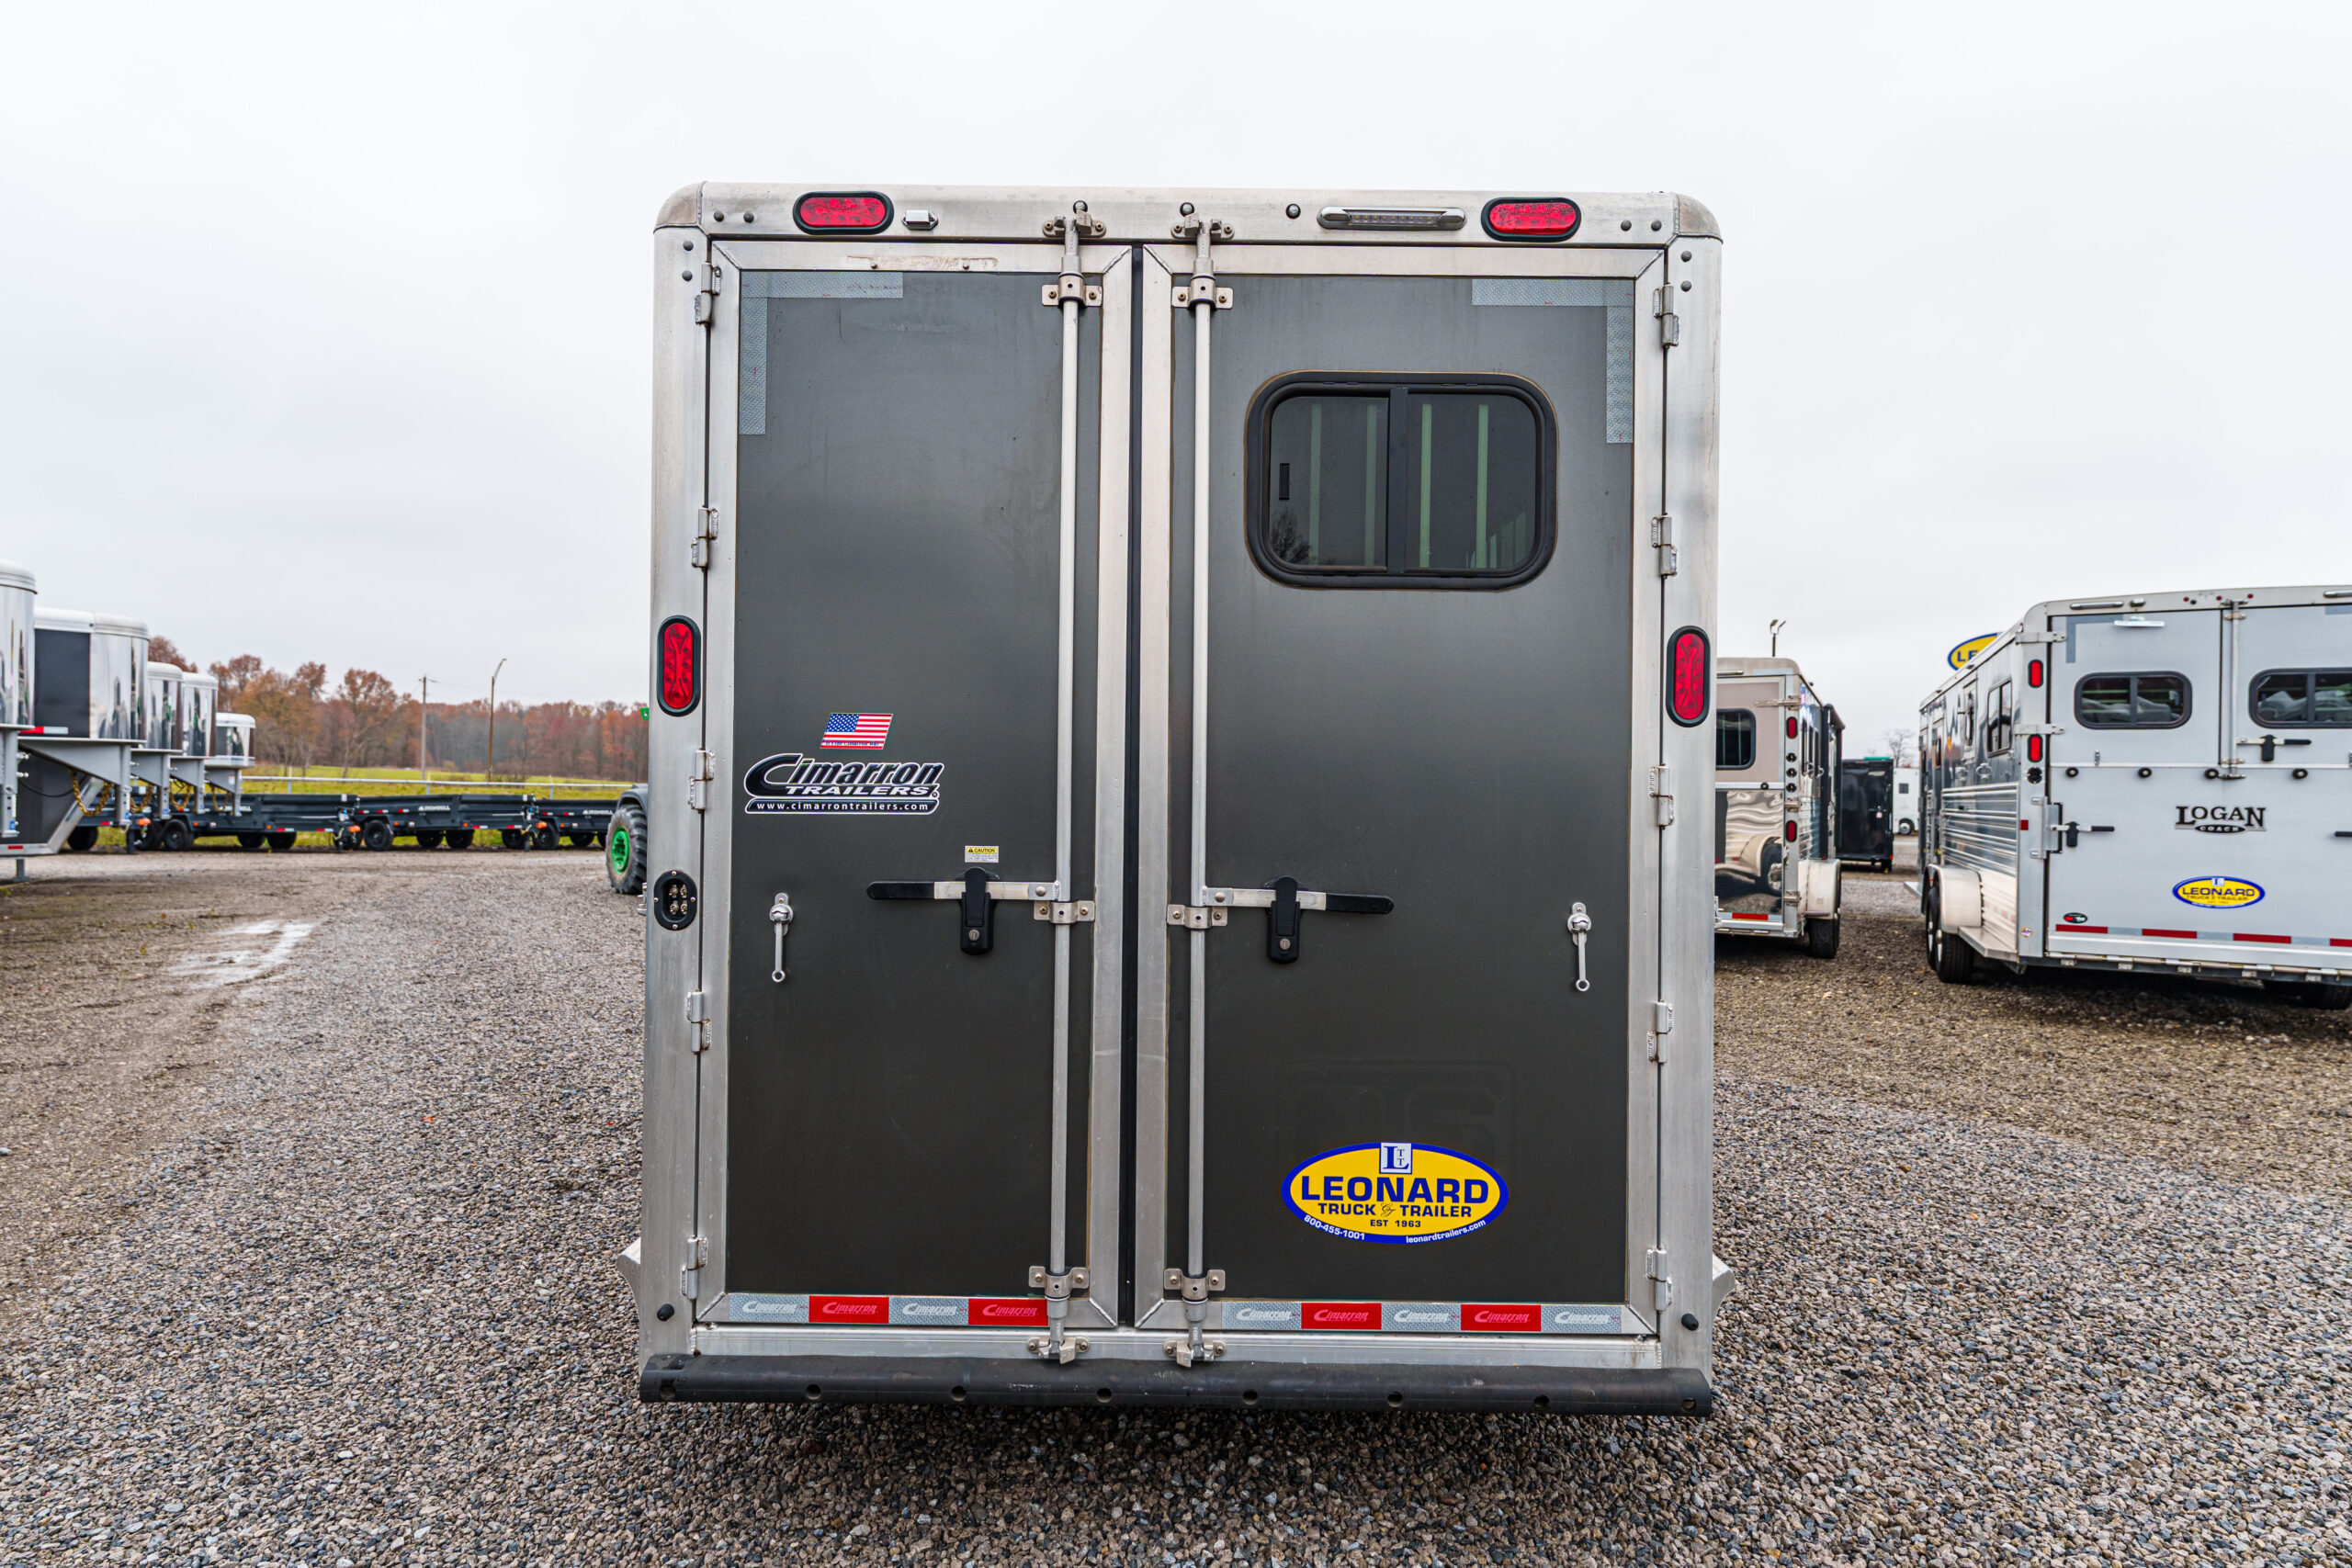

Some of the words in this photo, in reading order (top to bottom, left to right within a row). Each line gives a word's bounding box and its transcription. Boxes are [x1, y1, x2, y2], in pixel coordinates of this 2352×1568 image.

[745, 753, 944, 796] Cimarron
[785, 786, 930, 795] TRAILERS
[756, 802, 929, 810] www.cimarrontrailers.com
[2176, 806, 2266, 827] LOGAN
[2182, 887, 2255, 897] LEONARD
[1301, 1176, 1489, 1204] LEONARD
[1317, 1203, 1376, 1215] TRUCK
[1400, 1204, 1472, 1217] TRAILER
[1304, 1214, 1365, 1240] 800-455-1001
[1370, 1219, 1388, 1227] EST
[1395, 1220, 1421, 1228] 1963
[1406, 1219, 1486, 1244] leonardtrailers.com
[822, 1302, 877, 1314] Cimarron
[982, 1303, 1037, 1316] Cimarron
[1314, 1309, 1369, 1322] Cimarron
[1475, 1311, 1530, 1324] Cimarron
